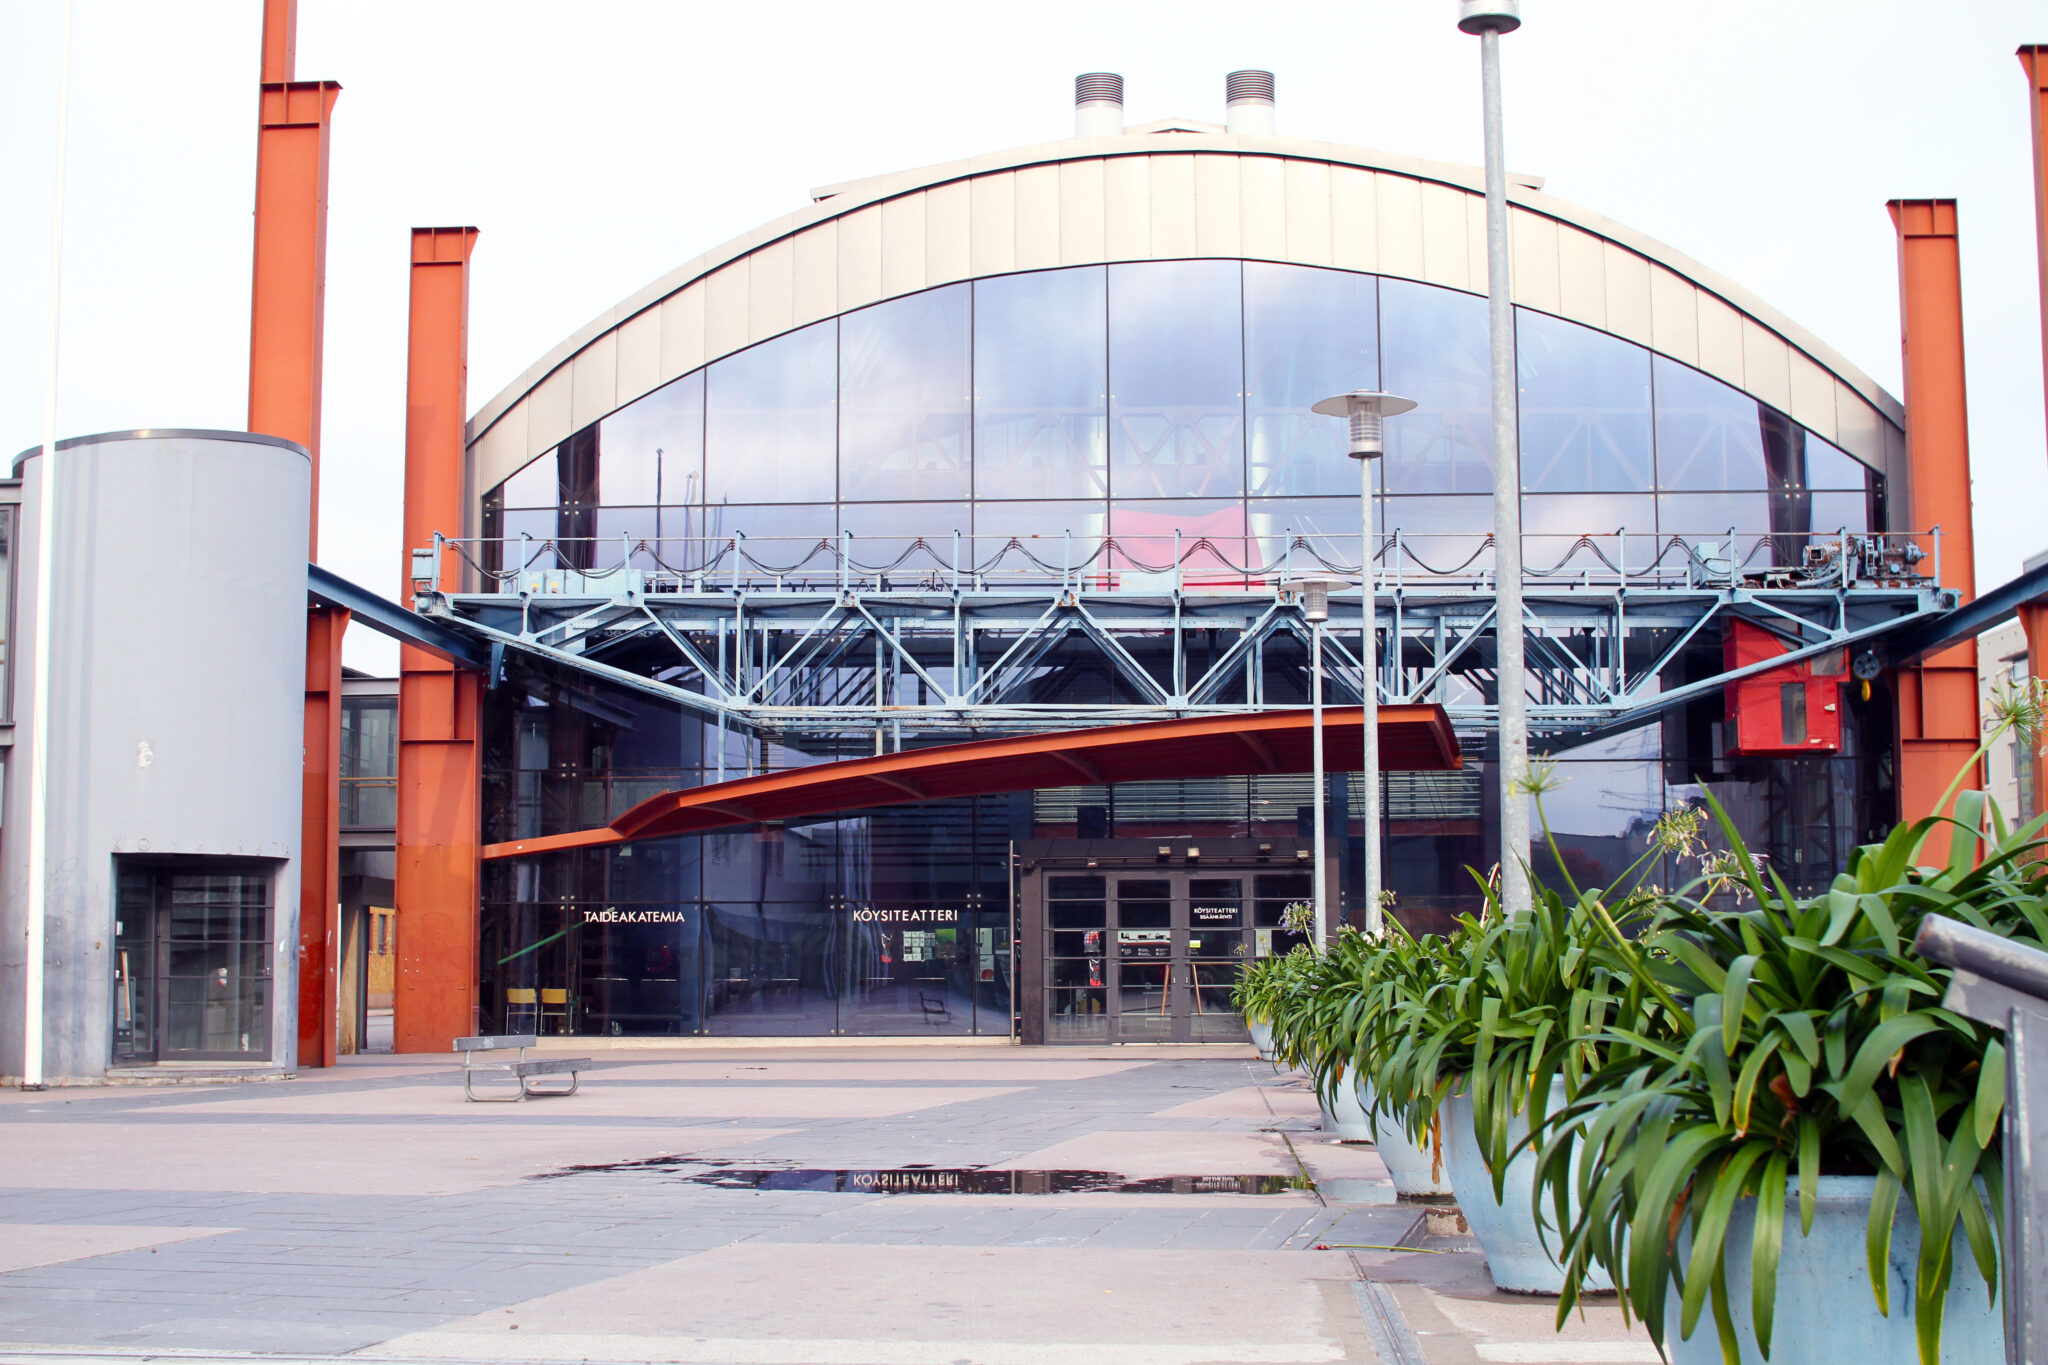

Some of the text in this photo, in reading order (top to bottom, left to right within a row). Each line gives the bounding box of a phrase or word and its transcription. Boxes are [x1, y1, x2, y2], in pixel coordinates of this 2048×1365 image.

[853, 907, 958, 921] KÖYSITEATTERI
[1193, 906, 1238, 914] KÖYSITEATTERI
[583, 911, 685, 923] TAIDEAKATEMIA
